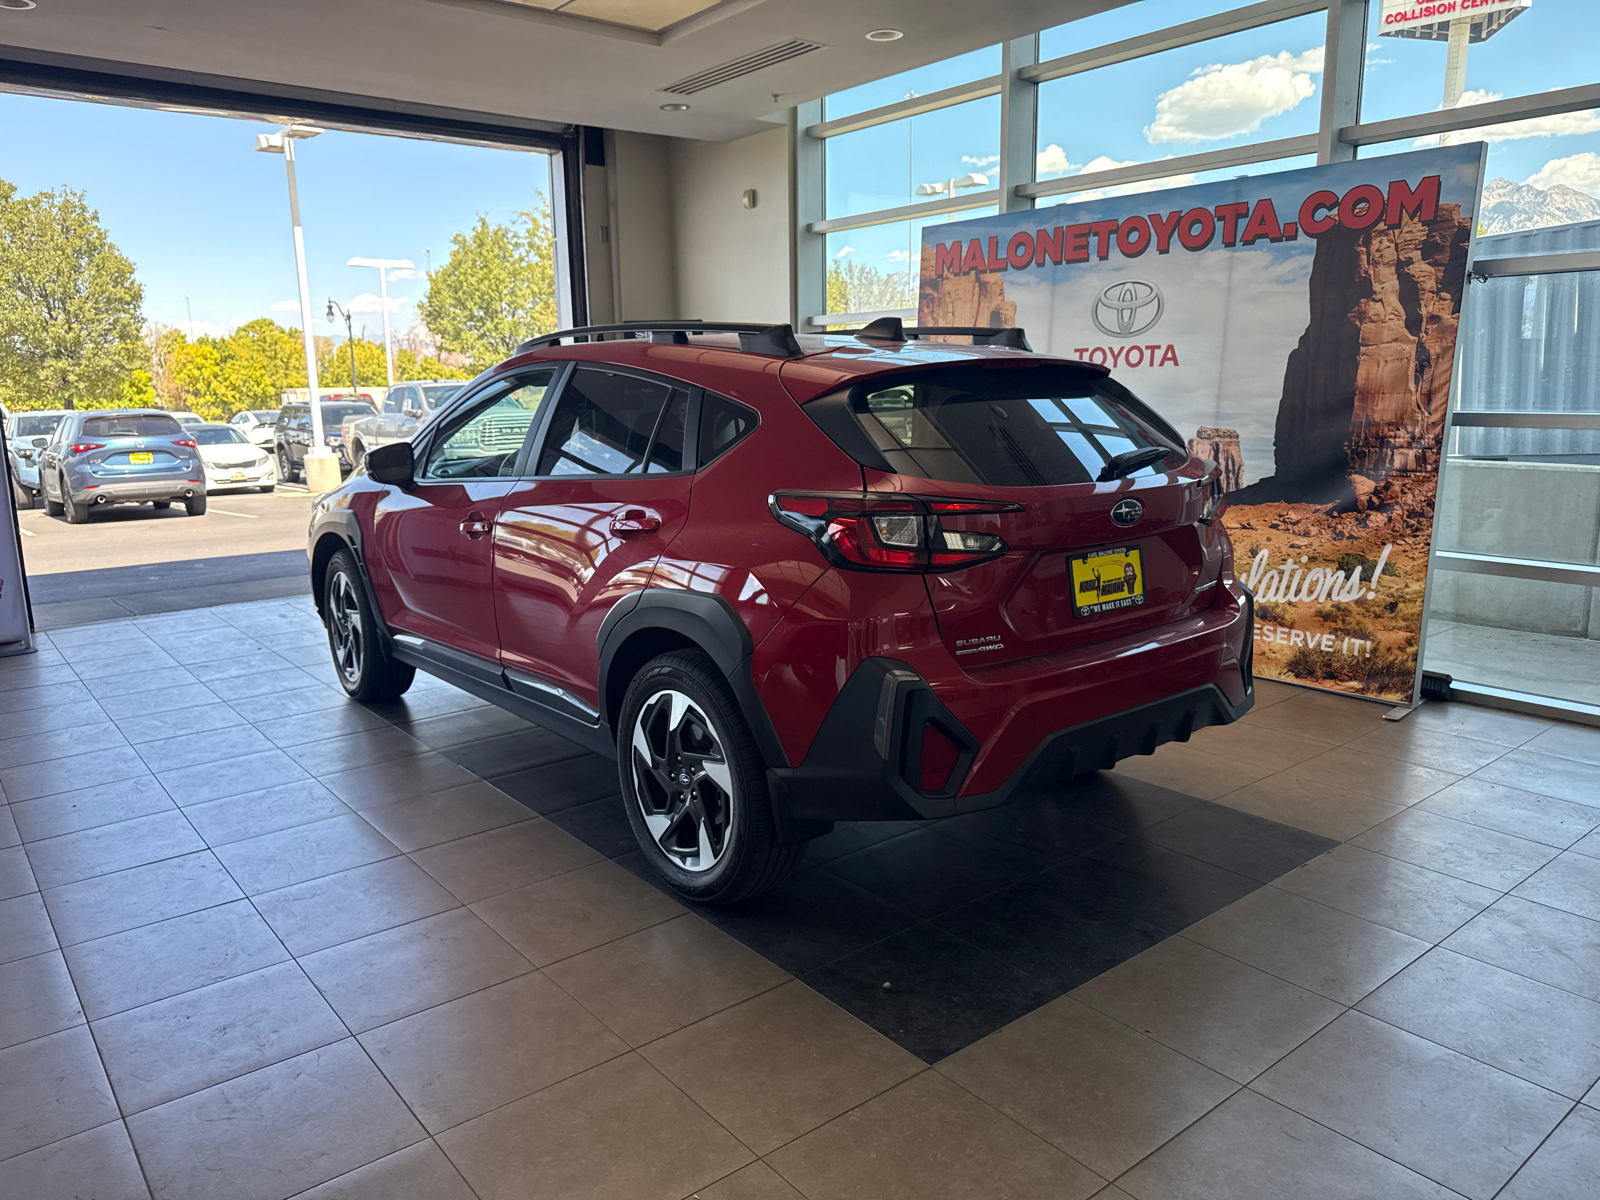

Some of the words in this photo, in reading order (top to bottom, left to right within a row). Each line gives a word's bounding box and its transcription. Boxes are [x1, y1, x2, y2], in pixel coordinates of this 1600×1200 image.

[1385, 1, 1456, 25] COLLISION
[1460, 0, 1513, 10] CEN
[935, 175, 1442, 277] MALONETOYOTA.COM
[1074, 343, 1179, 369] TOYOTA
[1126, 566, 1133, 575] 32
[1079, 579, 1097, 594] KARL
[1101, 580, 1125, 597] MALONE
[1102, 601, 1115, 611] MAKE
[1115, 600, 1120, 608] IT
[956, 635, 1000, 646] SUBARU
[1253, 623, 1335, 653] ESERVE
[1342, 637, 1371, 658] IT!
